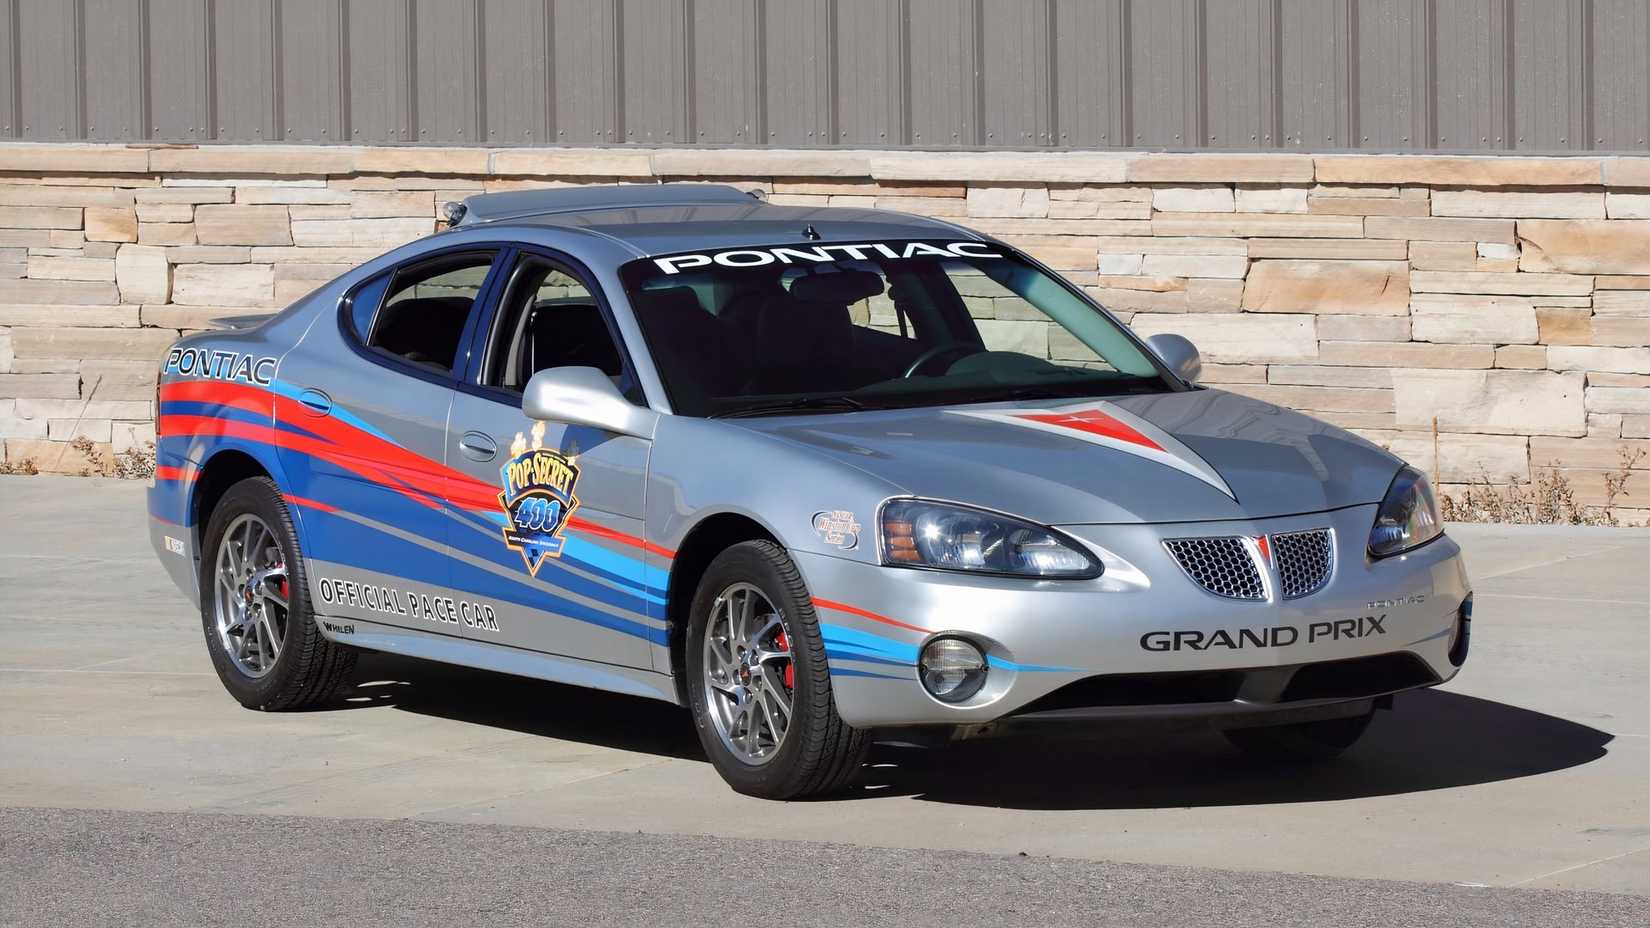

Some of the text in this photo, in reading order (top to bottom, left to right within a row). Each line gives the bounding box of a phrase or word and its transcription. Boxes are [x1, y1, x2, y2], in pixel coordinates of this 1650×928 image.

[653, 242, 1004, 275] PONTIAC
[164, 348, 277, 386] PONTIAC
[515, 497, 561, 532] 400
[319, 578, 500, 632] OFFICIAL PACE CAR
[1139, 614, 1386, 651] GRAND PRIX
